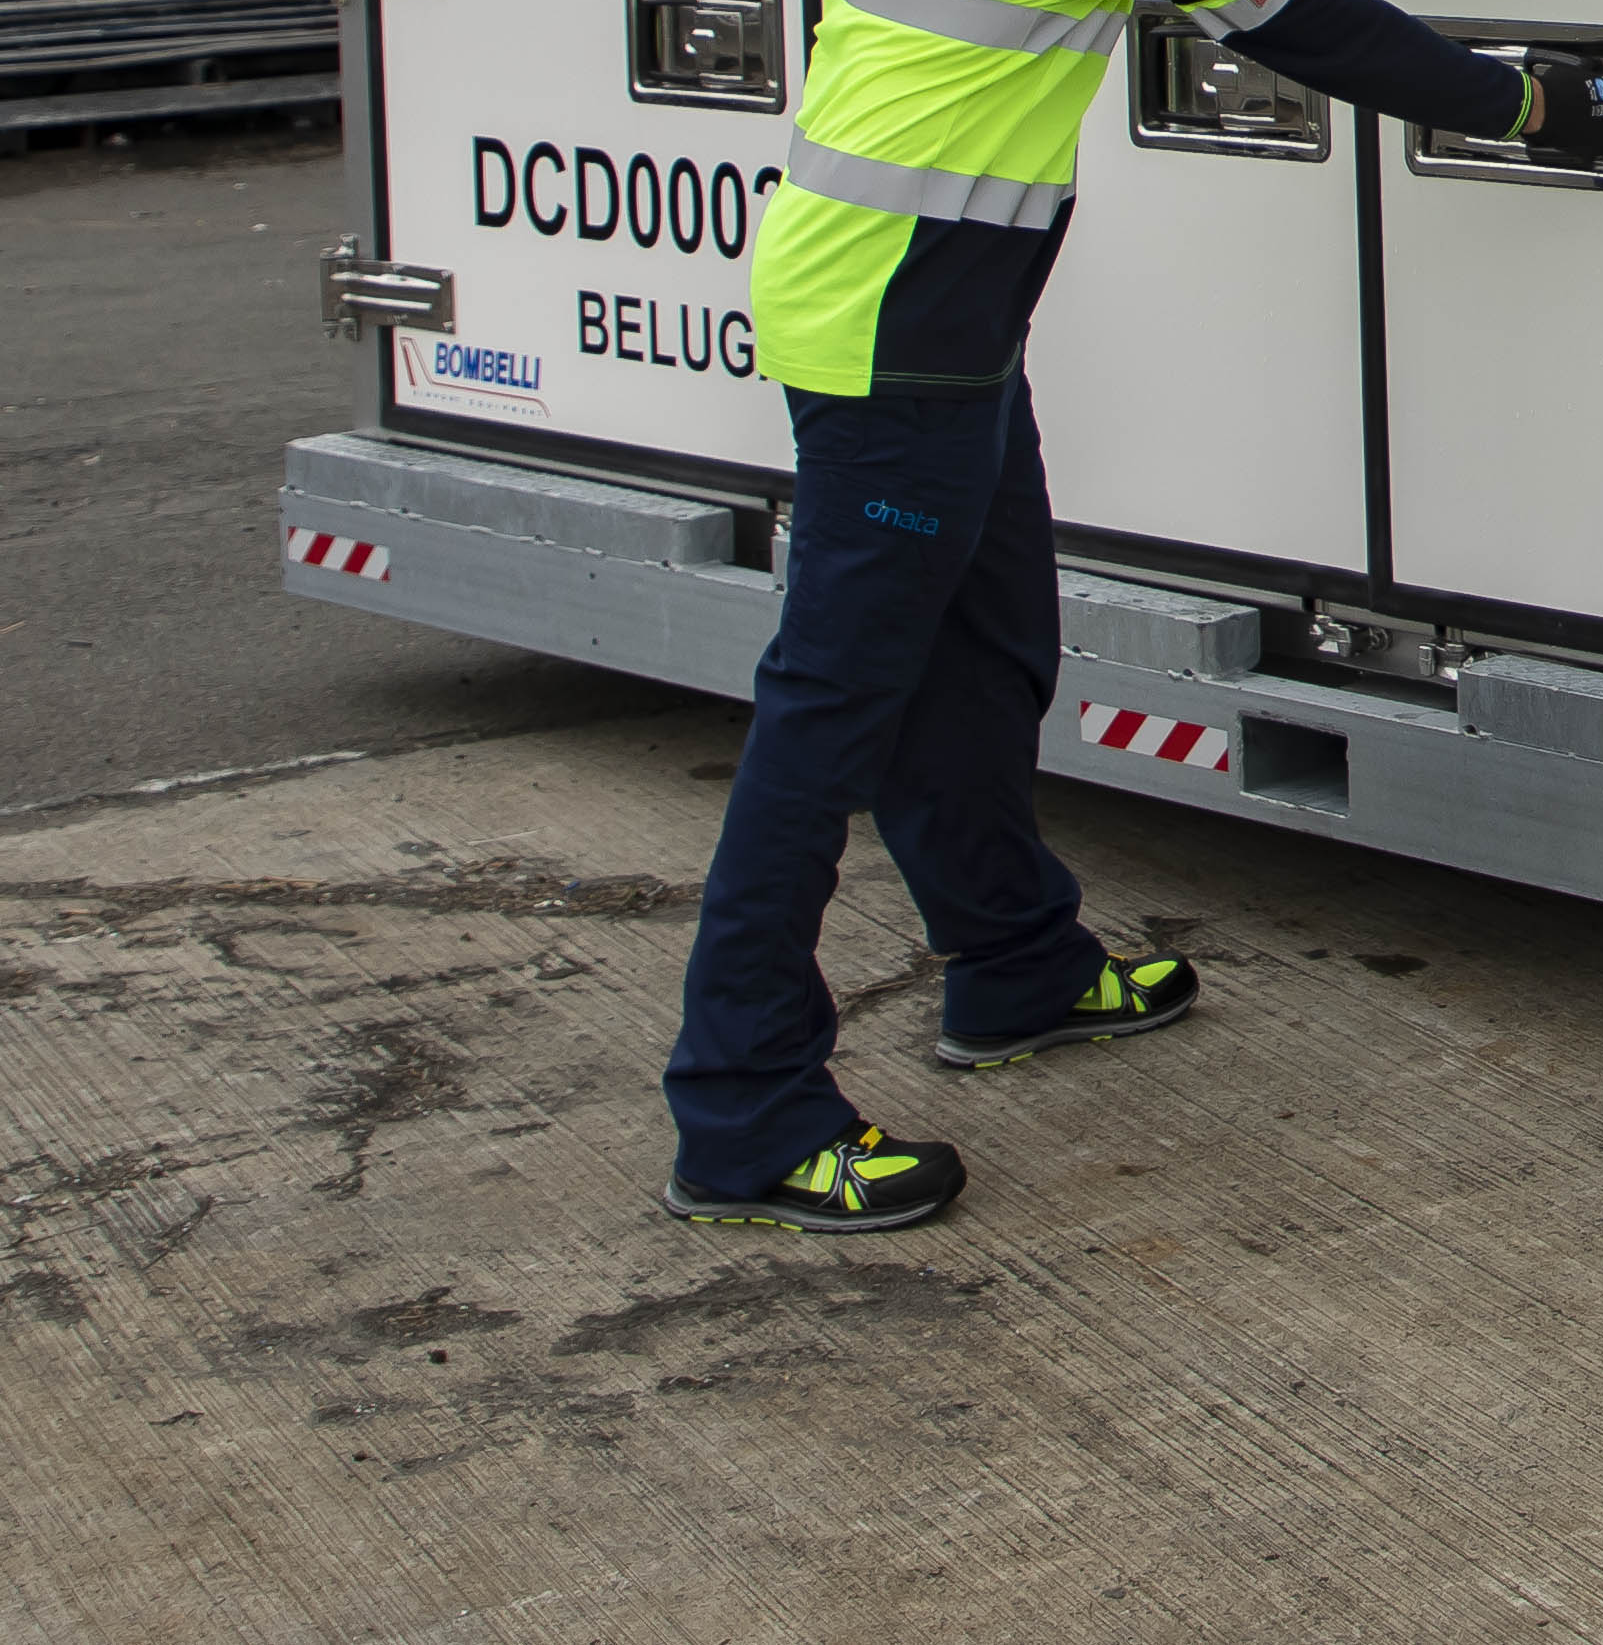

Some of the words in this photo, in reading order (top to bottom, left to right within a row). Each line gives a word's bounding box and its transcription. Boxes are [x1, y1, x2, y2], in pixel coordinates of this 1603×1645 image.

[576, 289, 768, 382] BELUG
[435, 341, 542, 391] BOMBELLI
[864, 499, 940, 537] dnata
